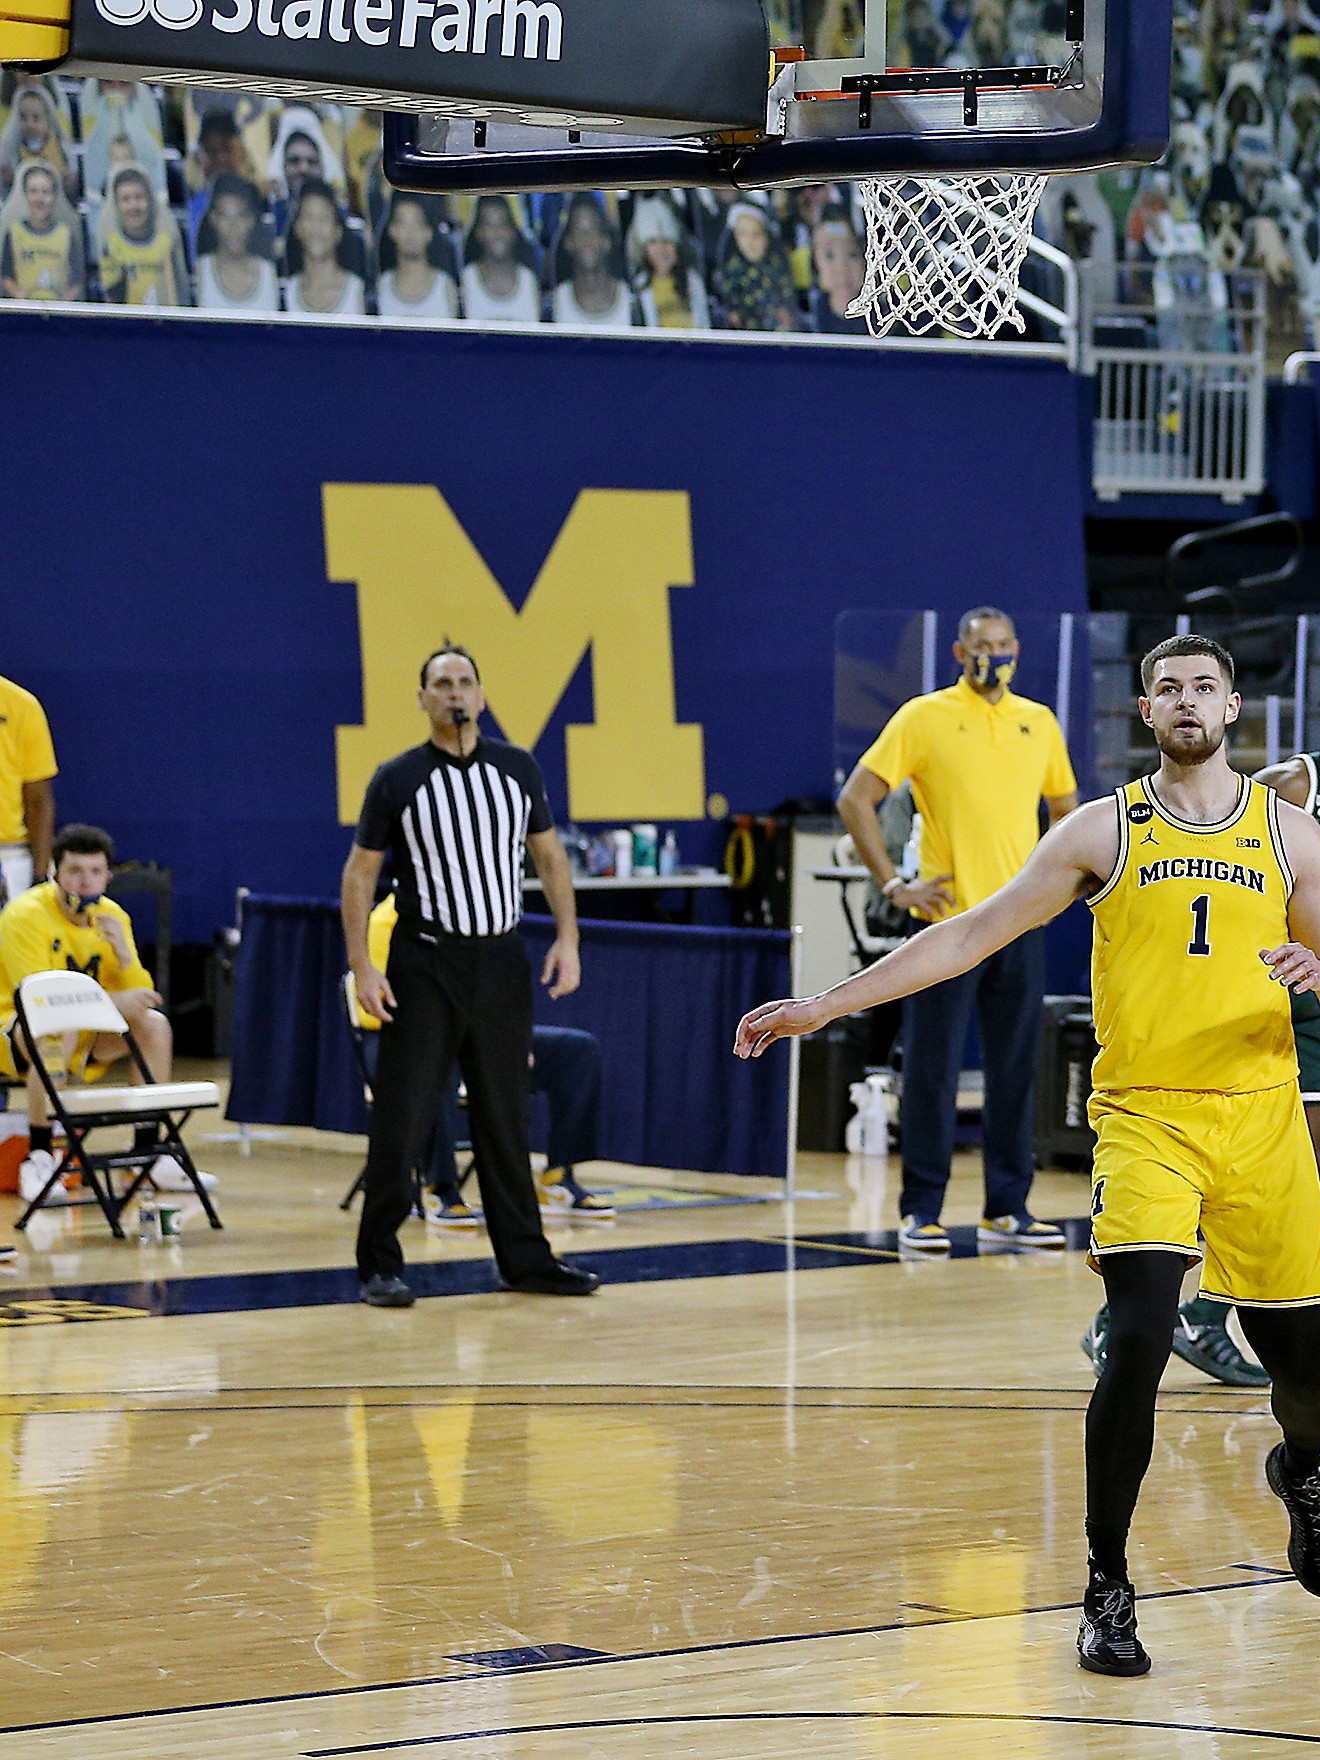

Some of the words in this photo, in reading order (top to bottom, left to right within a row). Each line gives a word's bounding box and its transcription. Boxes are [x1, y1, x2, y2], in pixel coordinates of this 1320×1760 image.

[321, 482, 705, 826] M
[1130, 807, 1151, 818] BLM
[1138, 858, 1267, 895] MICHIGAN
[1187, 893, 1212, 957] 1
